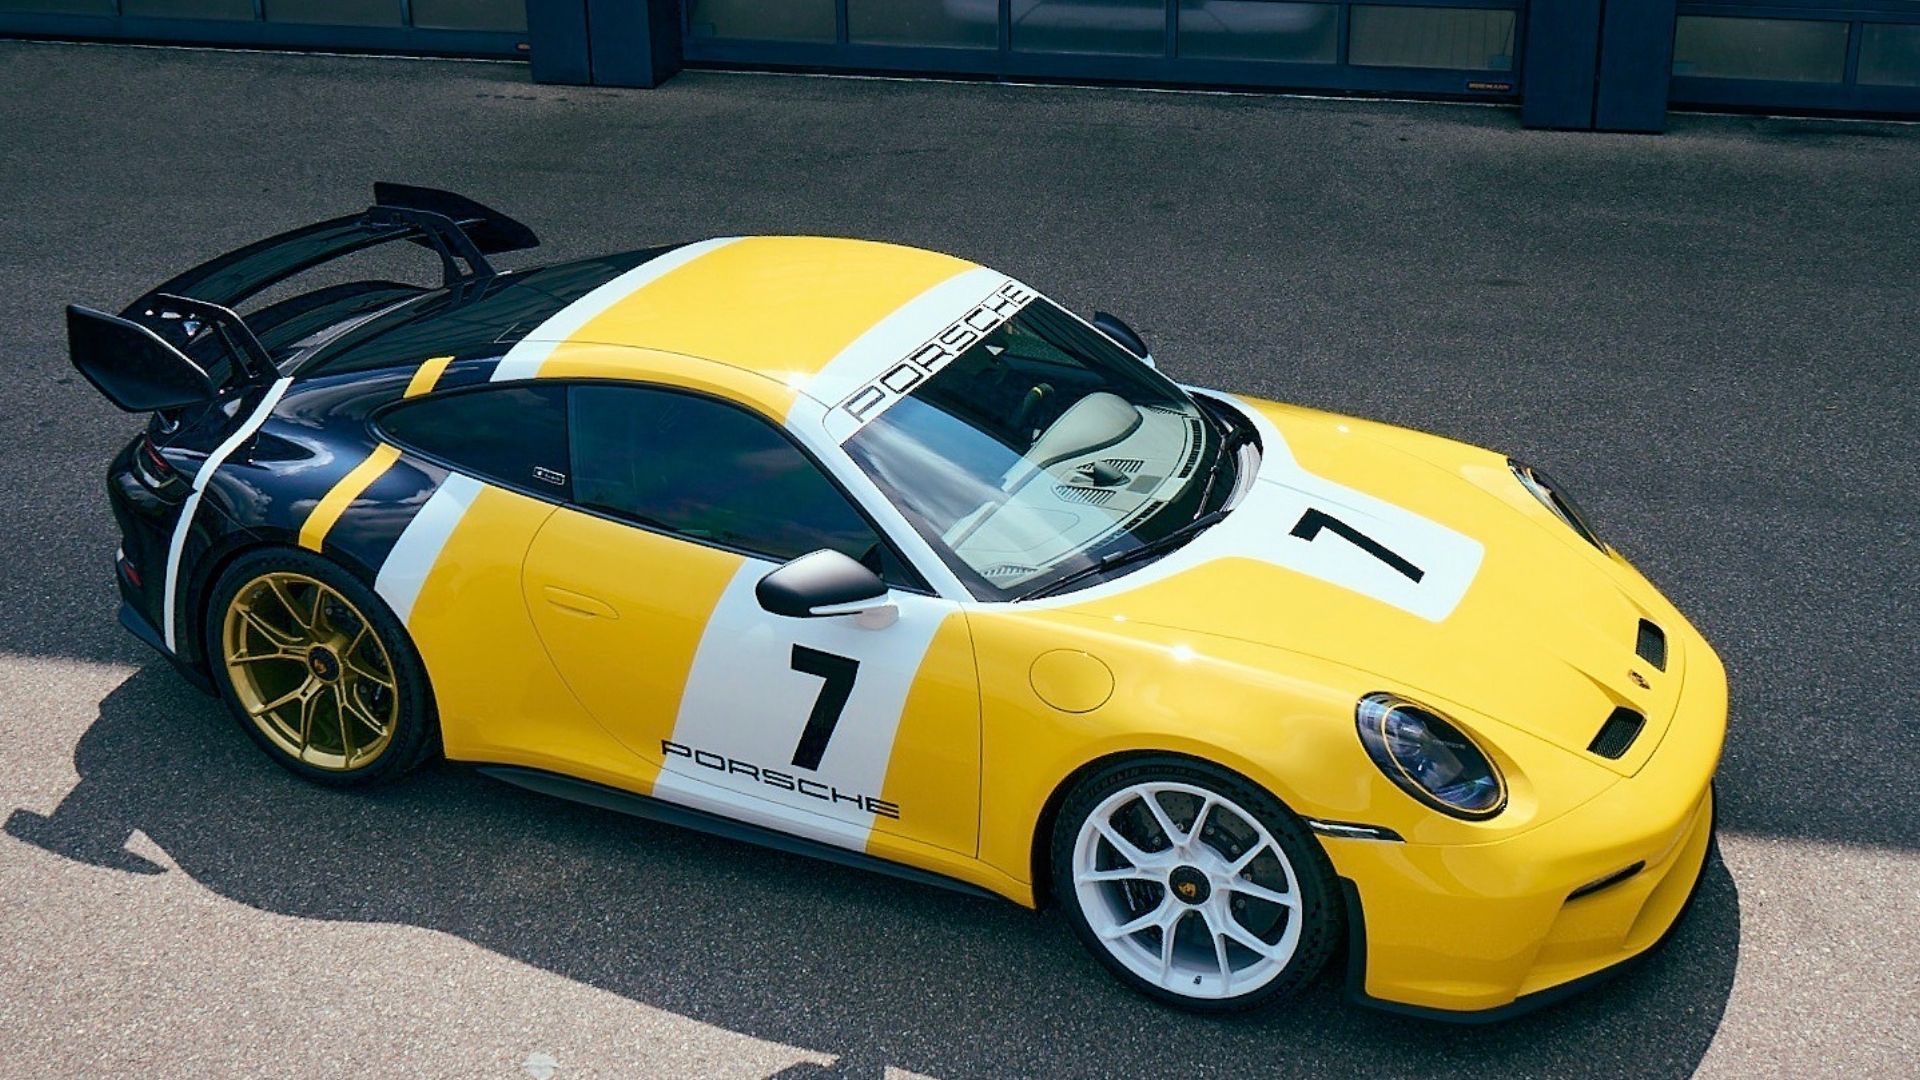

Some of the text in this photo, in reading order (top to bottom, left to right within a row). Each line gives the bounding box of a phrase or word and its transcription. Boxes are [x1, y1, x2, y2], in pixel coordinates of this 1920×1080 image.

[842, 284, 1030, 423] PORSCHE
[1288, 507, 1425, 584] 7
[790, 643, 860, 771] 7
[661, 739, 900, 820] PORSCHE
